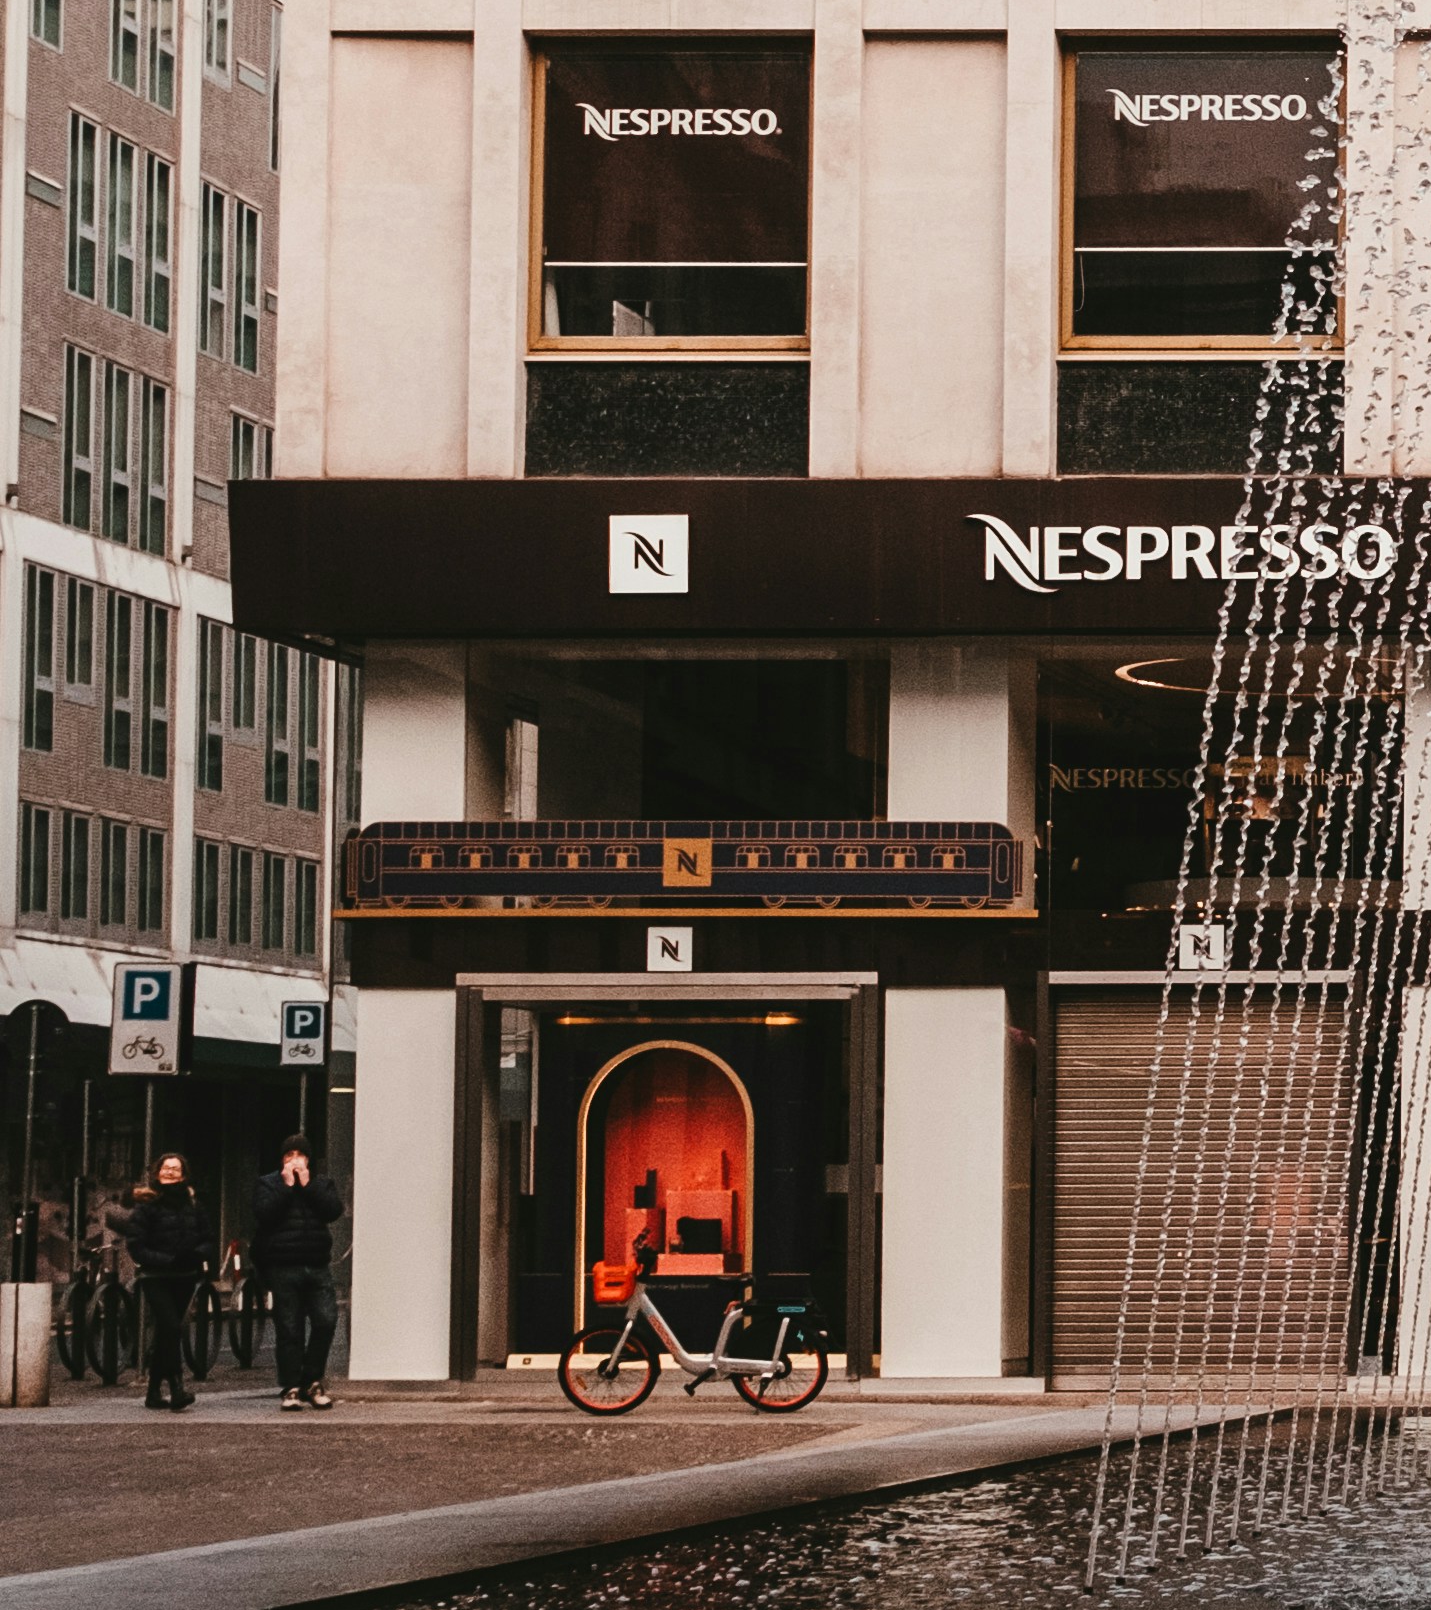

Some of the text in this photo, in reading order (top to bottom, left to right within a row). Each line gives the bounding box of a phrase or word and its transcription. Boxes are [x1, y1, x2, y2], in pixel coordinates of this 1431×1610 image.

[575, 102, 779, 142] NESPRESSO
[1105, 88, 1308, 127] NESPRESSO
[622, 531, 676, 577] N
[966, 513, 1397, 594] NESPRESSO
[132, 976, 161, 1015] P
[293, 1009, 315, 1036] P
